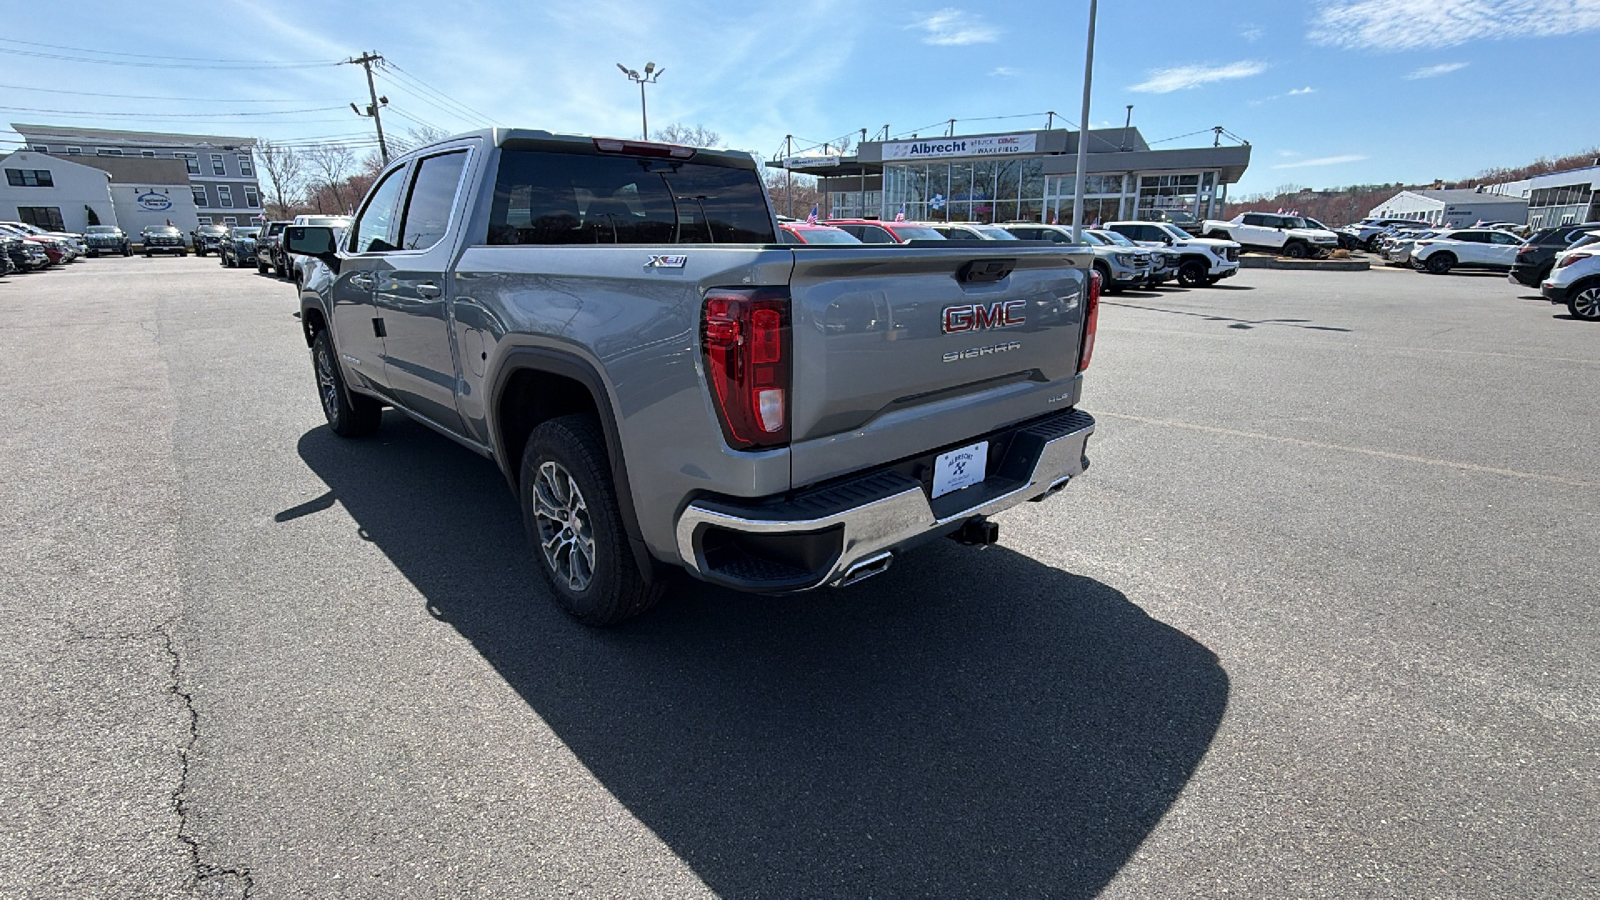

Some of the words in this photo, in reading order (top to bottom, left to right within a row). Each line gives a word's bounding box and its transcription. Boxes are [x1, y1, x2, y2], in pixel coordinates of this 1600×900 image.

[909, 141, 967, 154] Albrecht
[997, 137, 1020, 145] GMC
[977, 146, 1019, 154] WAKEFIELD
[942, 299, 1027, 335] GMC
[942, 341, 1021, 363] SIERRA
[947, 453, 974, 468] ALBRECHT
